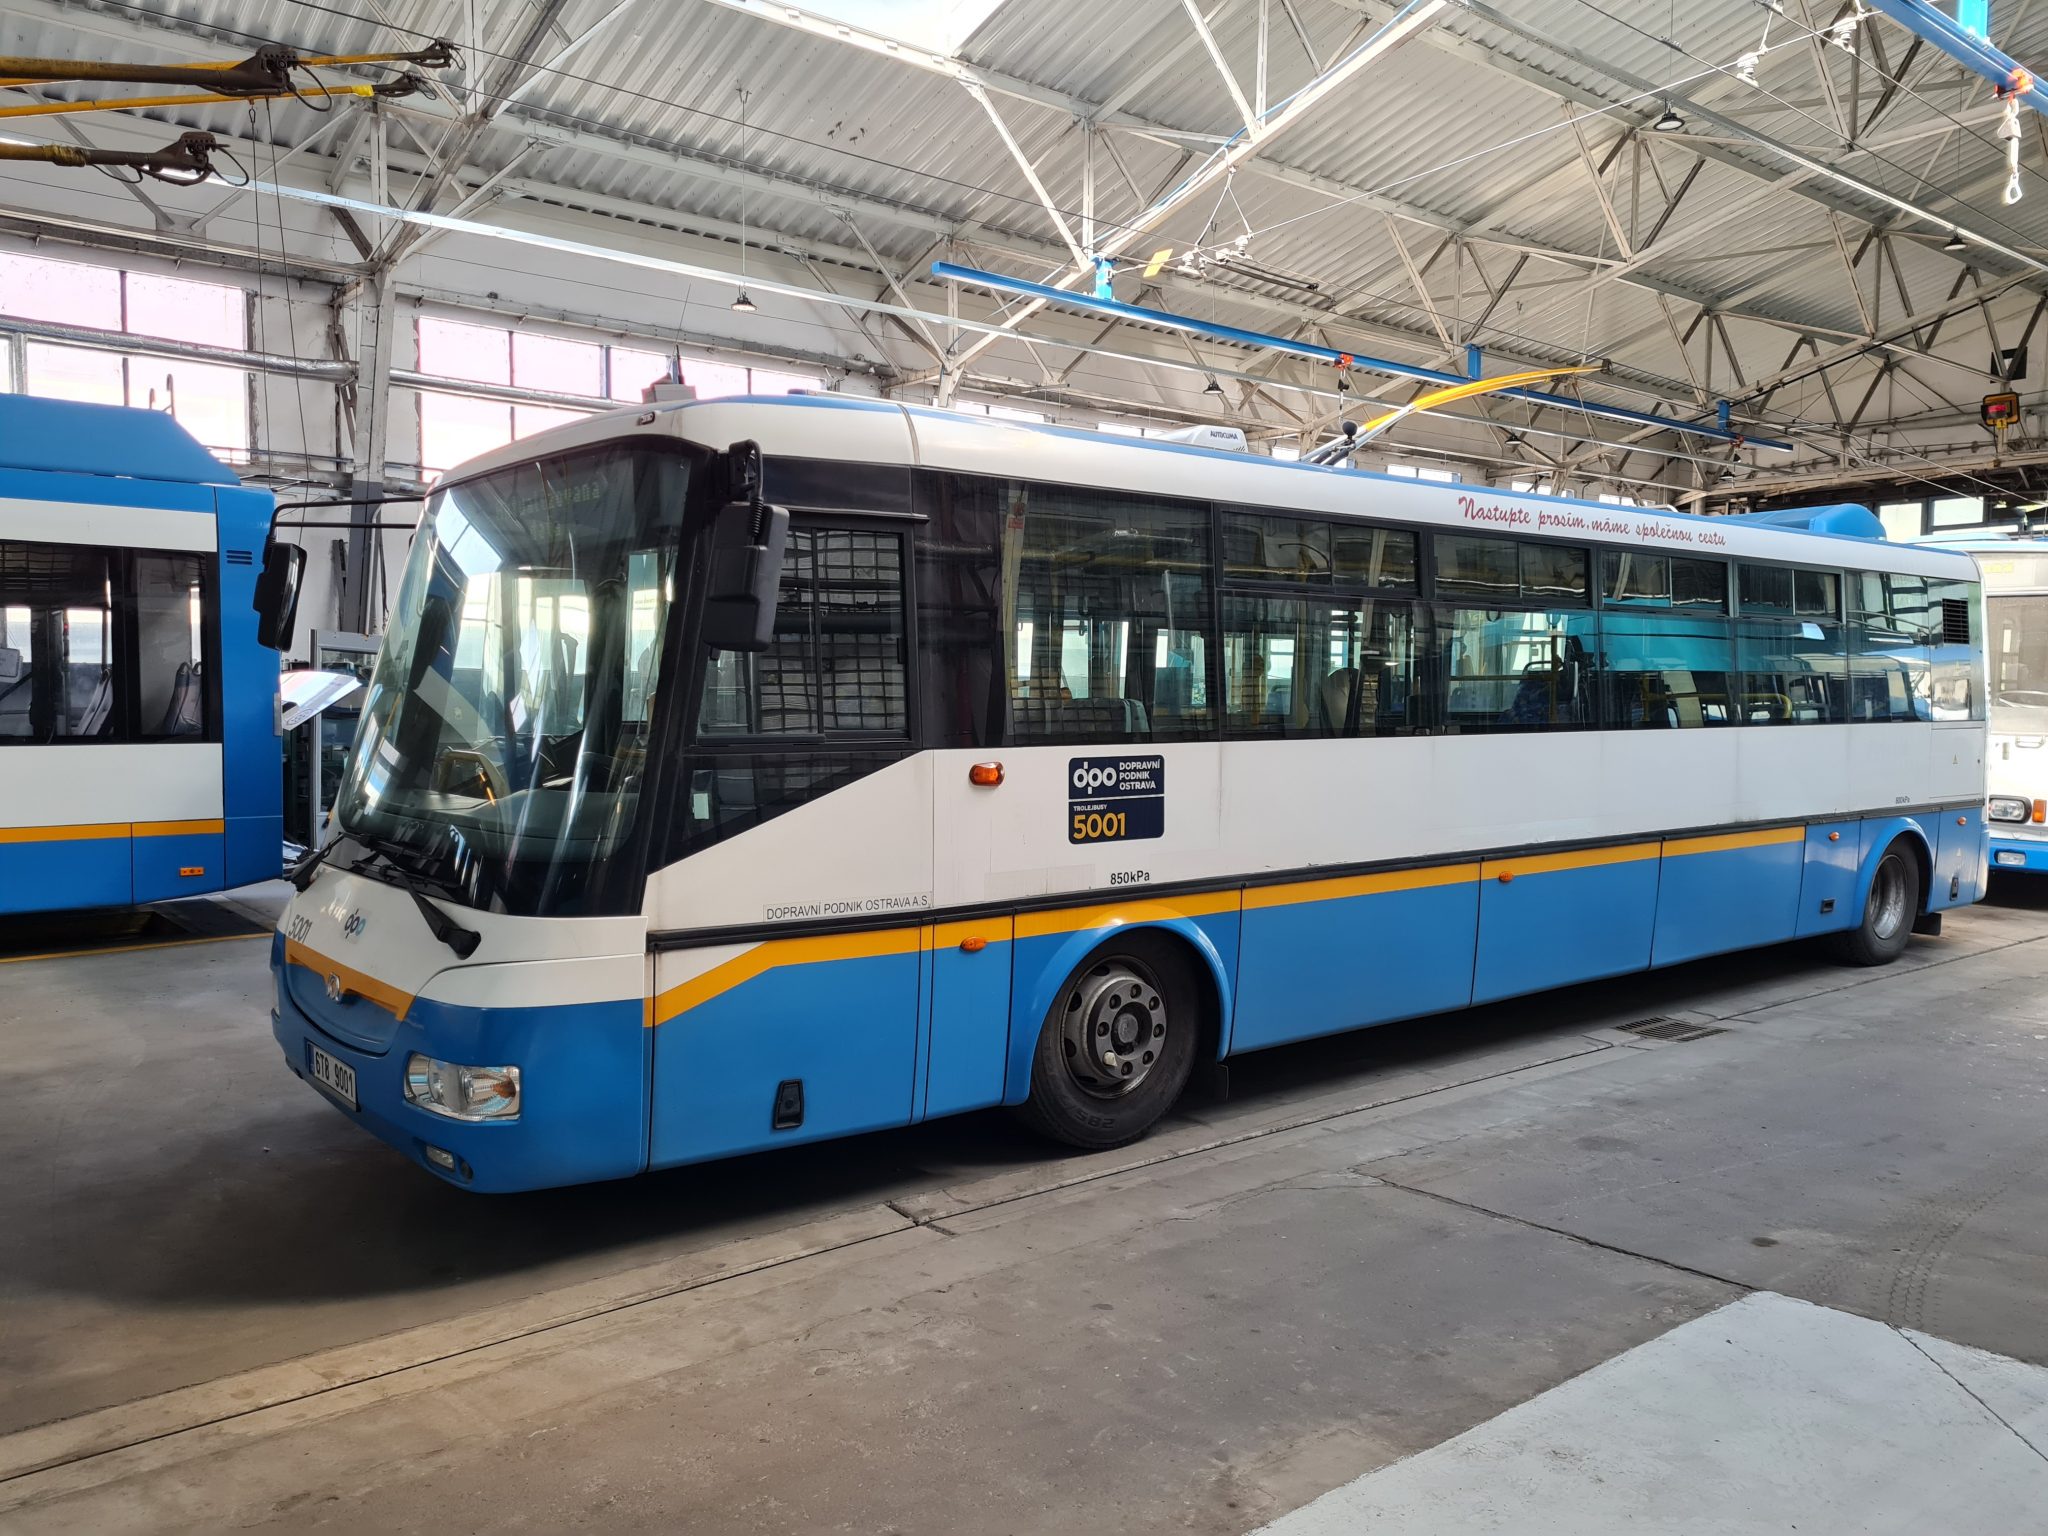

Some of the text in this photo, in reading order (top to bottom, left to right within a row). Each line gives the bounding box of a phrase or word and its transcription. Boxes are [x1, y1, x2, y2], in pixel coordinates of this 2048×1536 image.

[1458, 496, 1531, 525] Nastupte
[1591, 518, 1631, 535] máme
[1635, 521, 1693, 542] společnou
[1698, 531, 1727, 546] cestu
[1119, 759, 1161, 771] DOPRAVNÍ
[1119, 771, 1150, 780] PODNIK
[1073, 761, 1117, 795] dpo
[1119, 780, 1157, 791] OSTRAVA
[1073, 804, 1108, 812] TROLEJBUSY
[1073, 812, 1126, 840] 5001
[1110, 870, 1150, 885] 850kPa
[766, 902, 821, 920] DOPRAVNÍ
[824, 901, 863, 915] PODNIK
[865, 897, 911, 912] OSTRAVA
[288, 914, 313, 944] 5001
[315, 1051, 354, 1098] 6T8 9001
